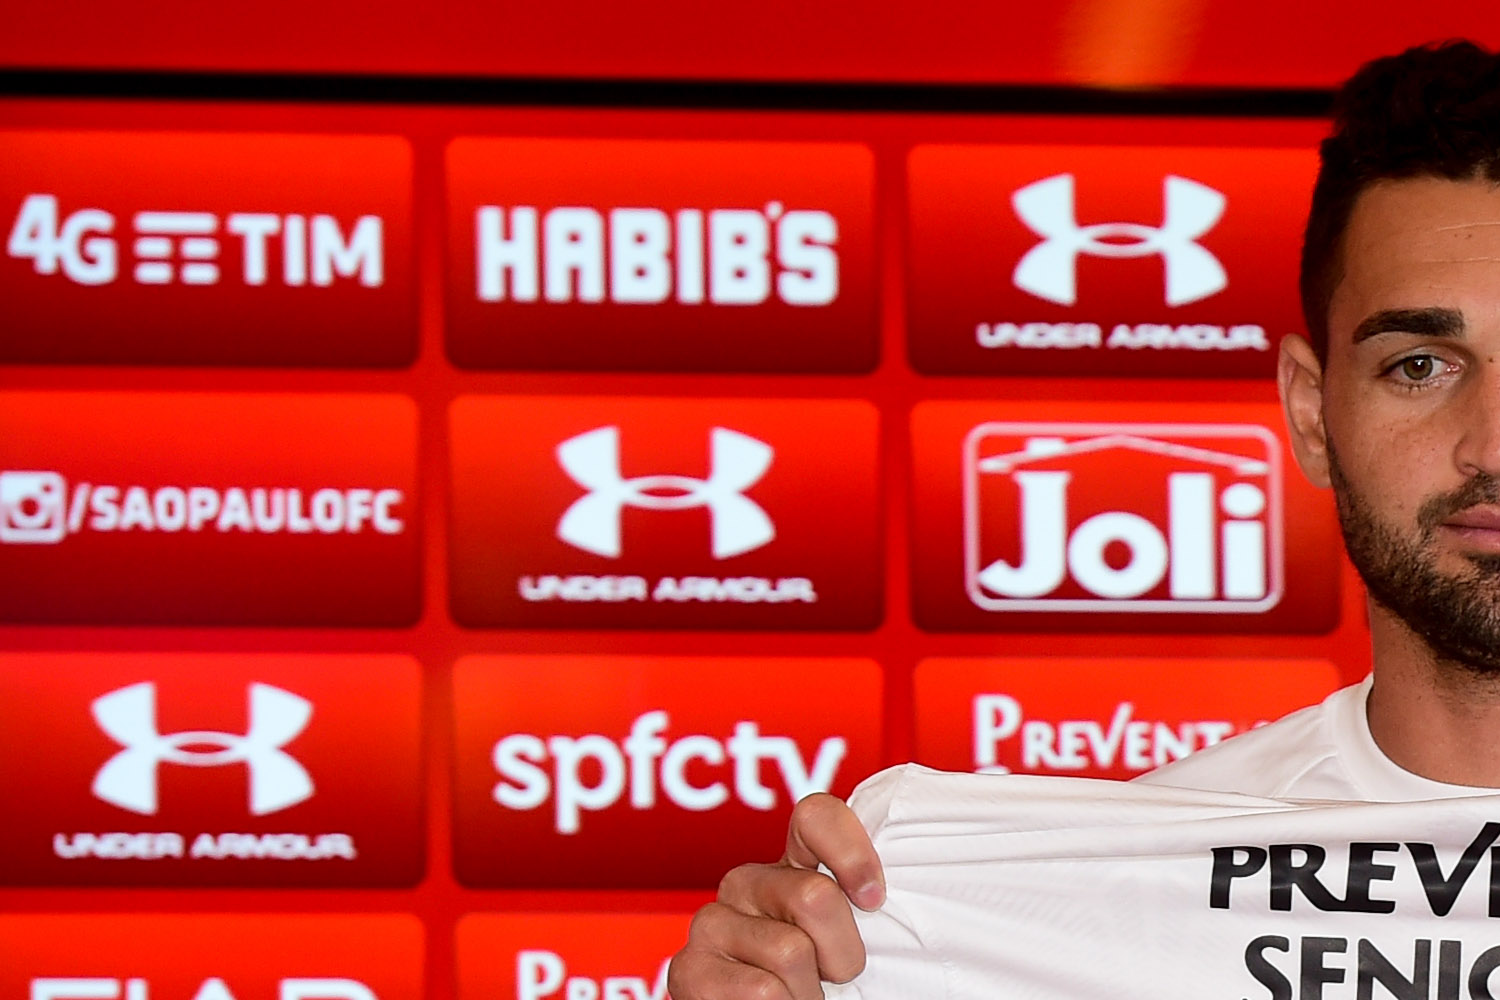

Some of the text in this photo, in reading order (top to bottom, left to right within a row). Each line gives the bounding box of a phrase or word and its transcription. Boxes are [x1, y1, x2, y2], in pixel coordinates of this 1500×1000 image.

[9, 195, 383, 286] 4G TIM
[477, 202, 838, 305] HABIB'S
[978, 323, 1268, 349] UNDER ARMOUR
[66, 484, 402, 533] /SAOPAULOFC
[977, 468, 1267, 599] Joli
[520, 576, 815, 602] UNDER ARMOUR
[492, 709, 847, 836] spfctv
[55, 833, 355, 859] UNDER ARMOUR
